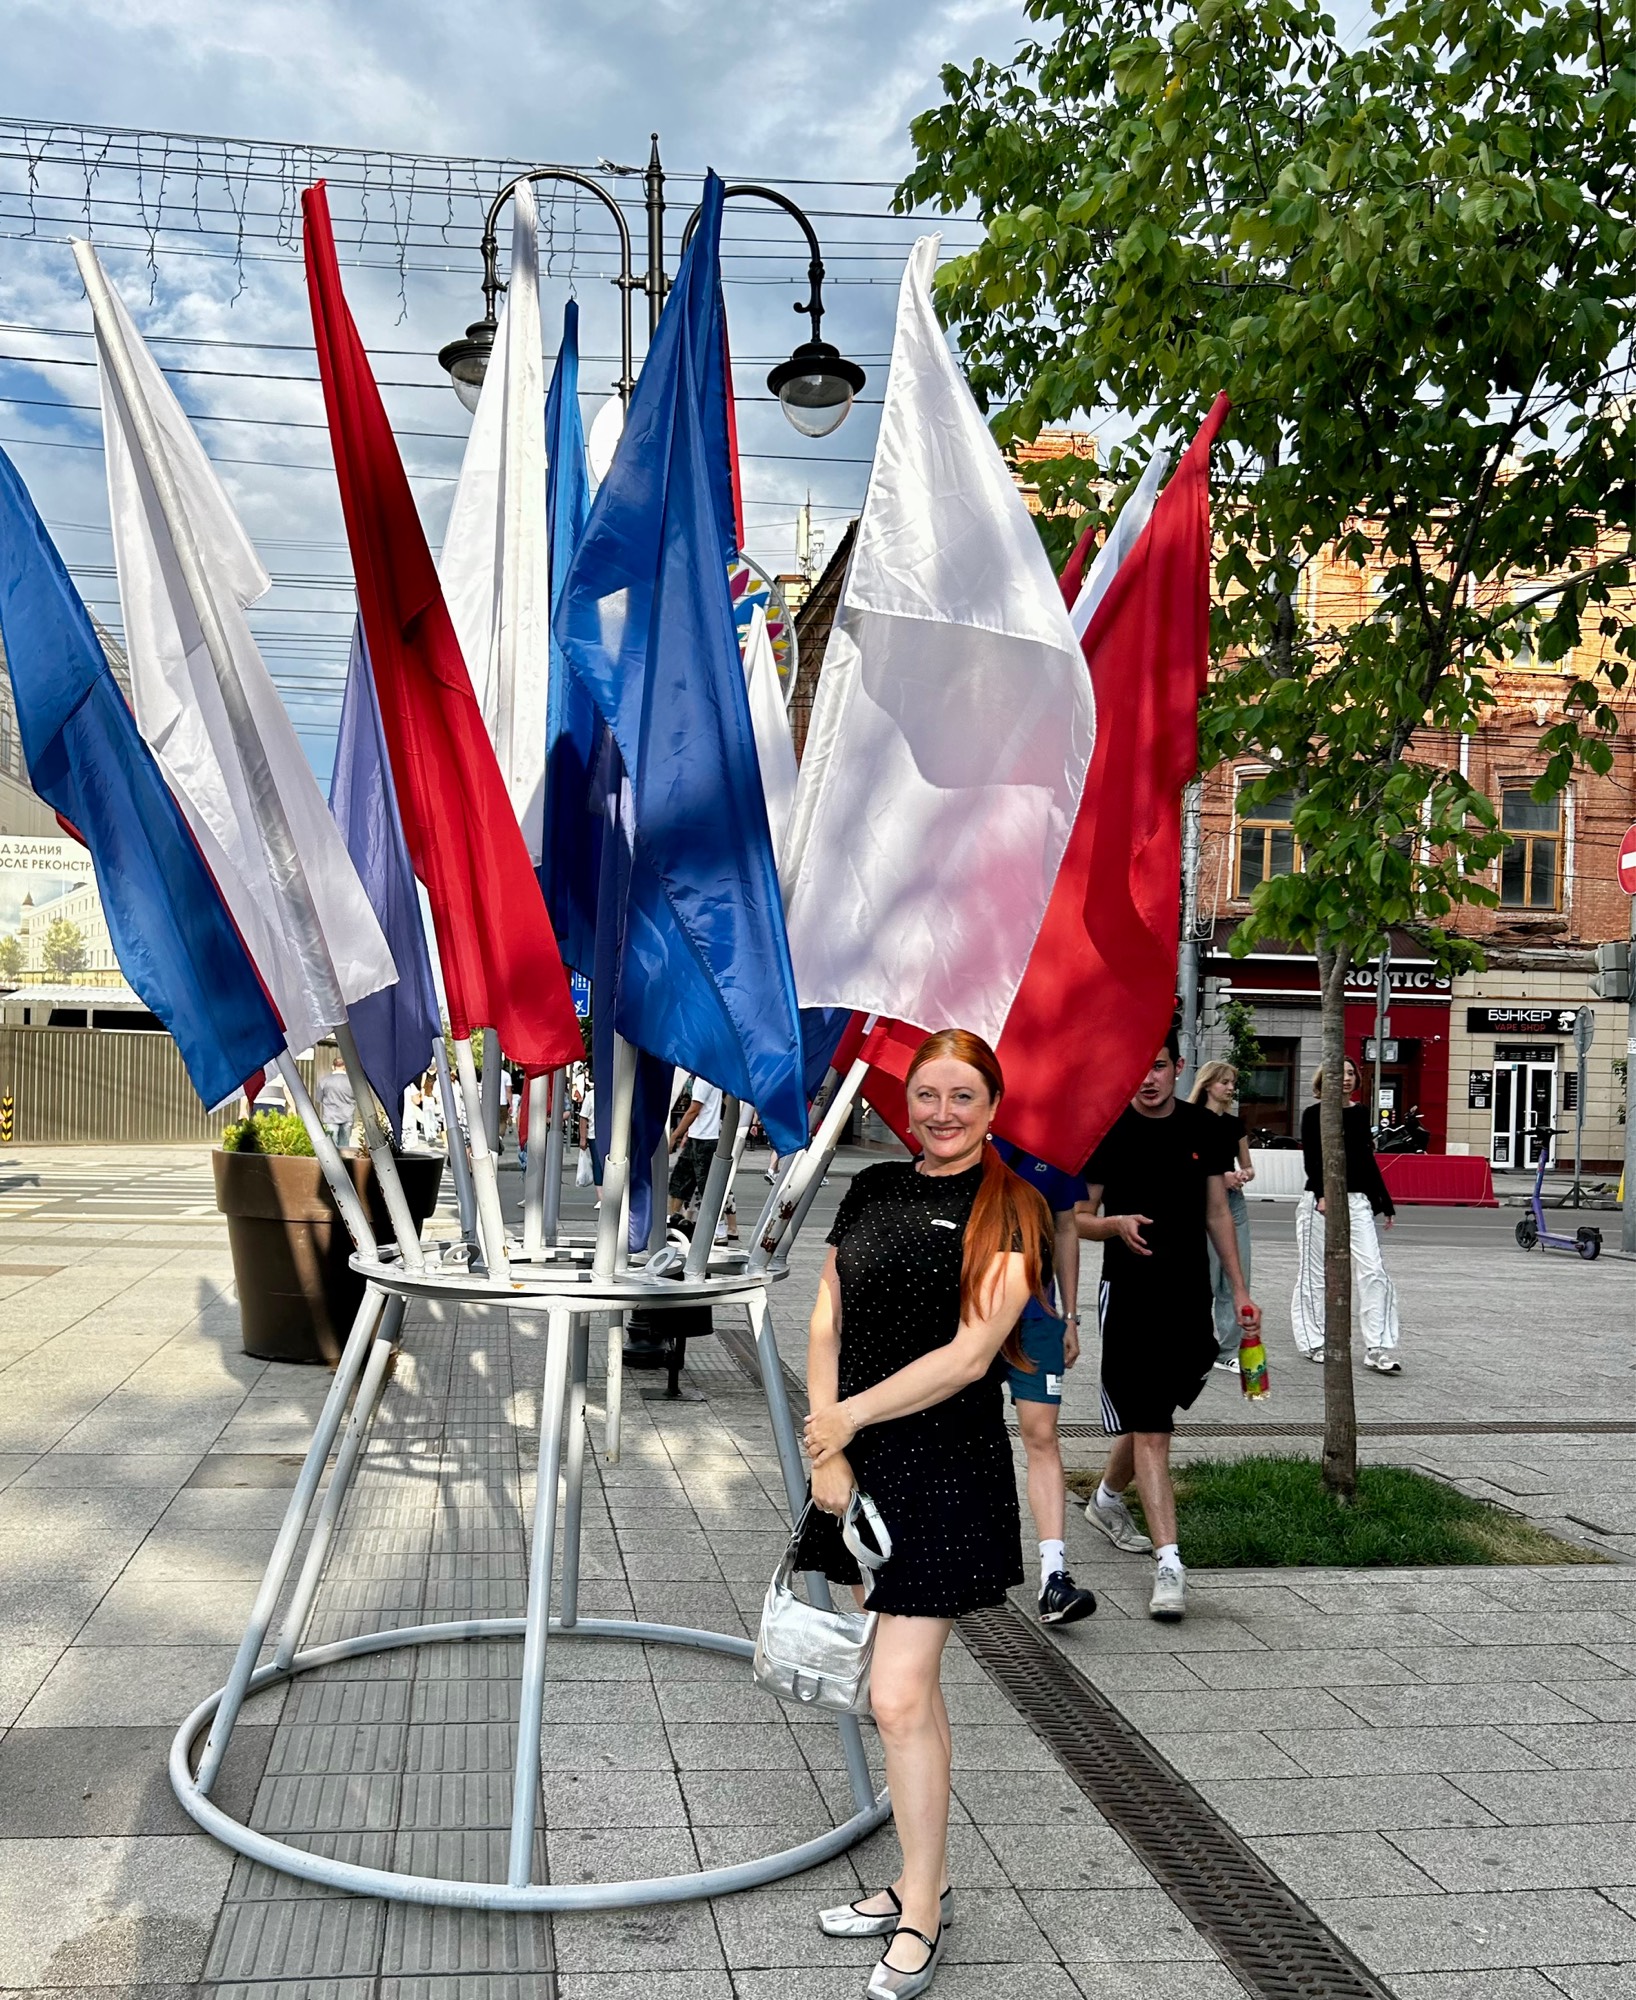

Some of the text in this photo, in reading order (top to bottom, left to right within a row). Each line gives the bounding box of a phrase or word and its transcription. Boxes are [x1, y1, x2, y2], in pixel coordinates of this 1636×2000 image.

[14, 843, 62, 855] ЗДАНИЯ
[32, 859, 95, 871] РЕКОНСТР
[1488, 1009, 1552, 1022] БУНКЕР
[1494, 1023, 1546, 1032] VAPE SHOP
